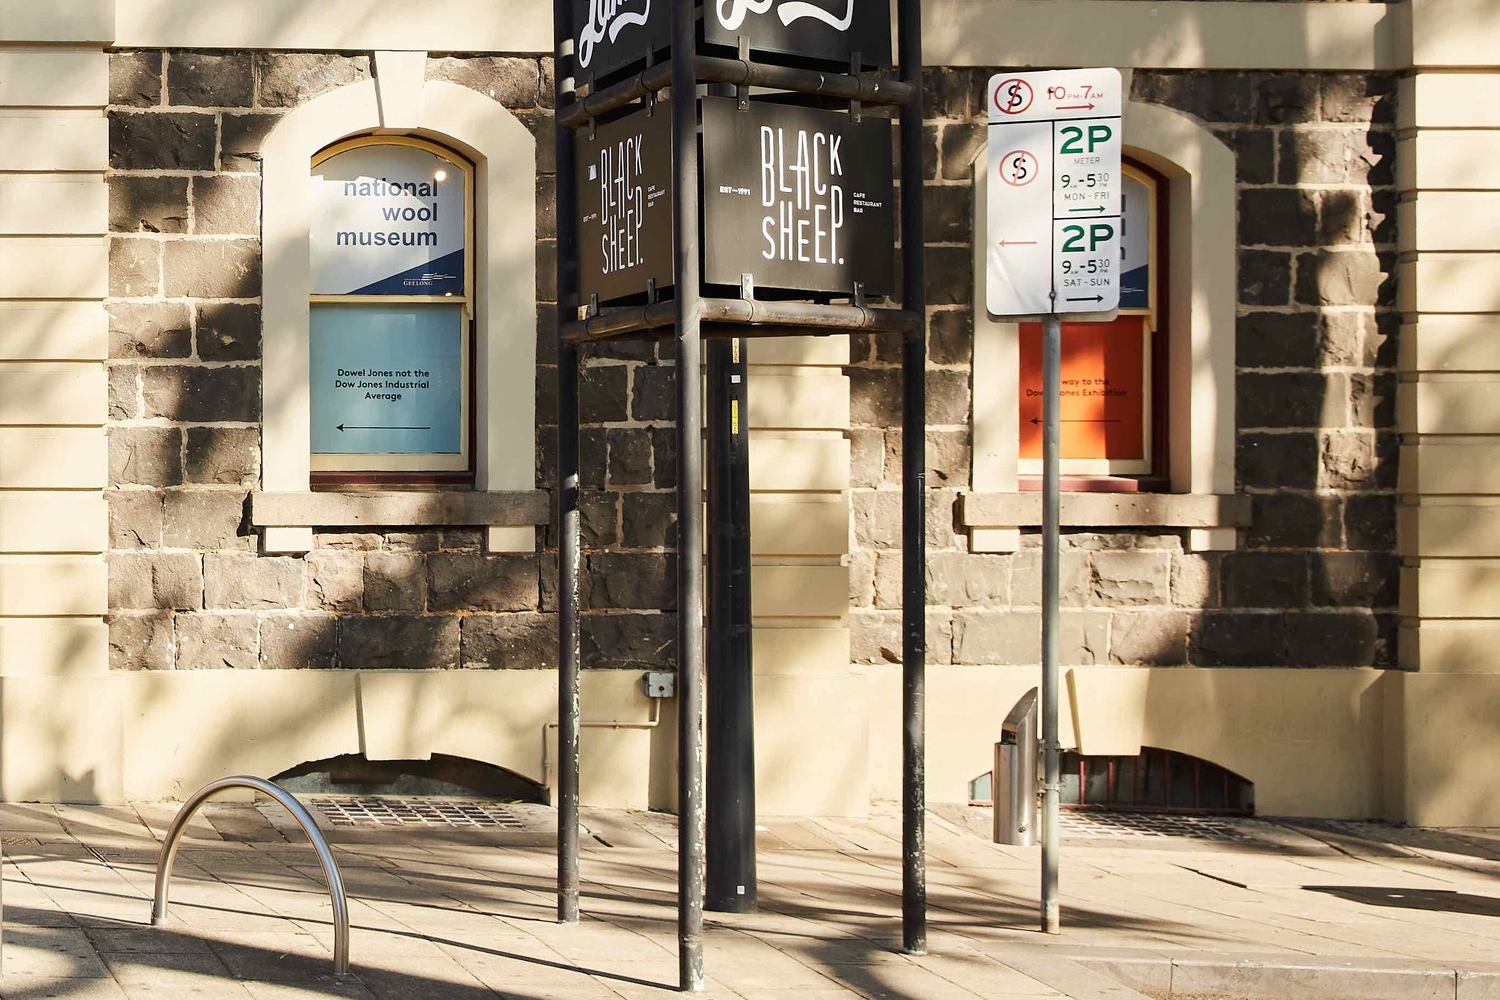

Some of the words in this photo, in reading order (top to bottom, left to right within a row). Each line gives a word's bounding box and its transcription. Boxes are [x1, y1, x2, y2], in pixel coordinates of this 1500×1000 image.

[1059, 124, 1113, 155] 2P
[1073, 157, 1101, 165] METER
[760, 125, 843, 211] BLACK
[600, 133, 643, 226] BLACK
[344, 177, 438, 197] national
[852, 199, 883, 208] RESTAURANT
[382, 202, 438, 222] wool
[336, 230, 438, 246] museum
[1061, 223, 1114, 253] 2P
[337, 368, 366, 377] Dowel
[367, 369, 393, 377] Jones
[395, 369, 411, 377] not
[414, 369, 430, 377] the
[335, 380, 356, 388] Dow
[357, 380, 383, 388] Jones
[385, 380, 430, 389] Industrial
[1061, 379, 1080, 387] way
[364, 391, 403, 402] Average
[1082, 388, 1127, 397] Exhibition
